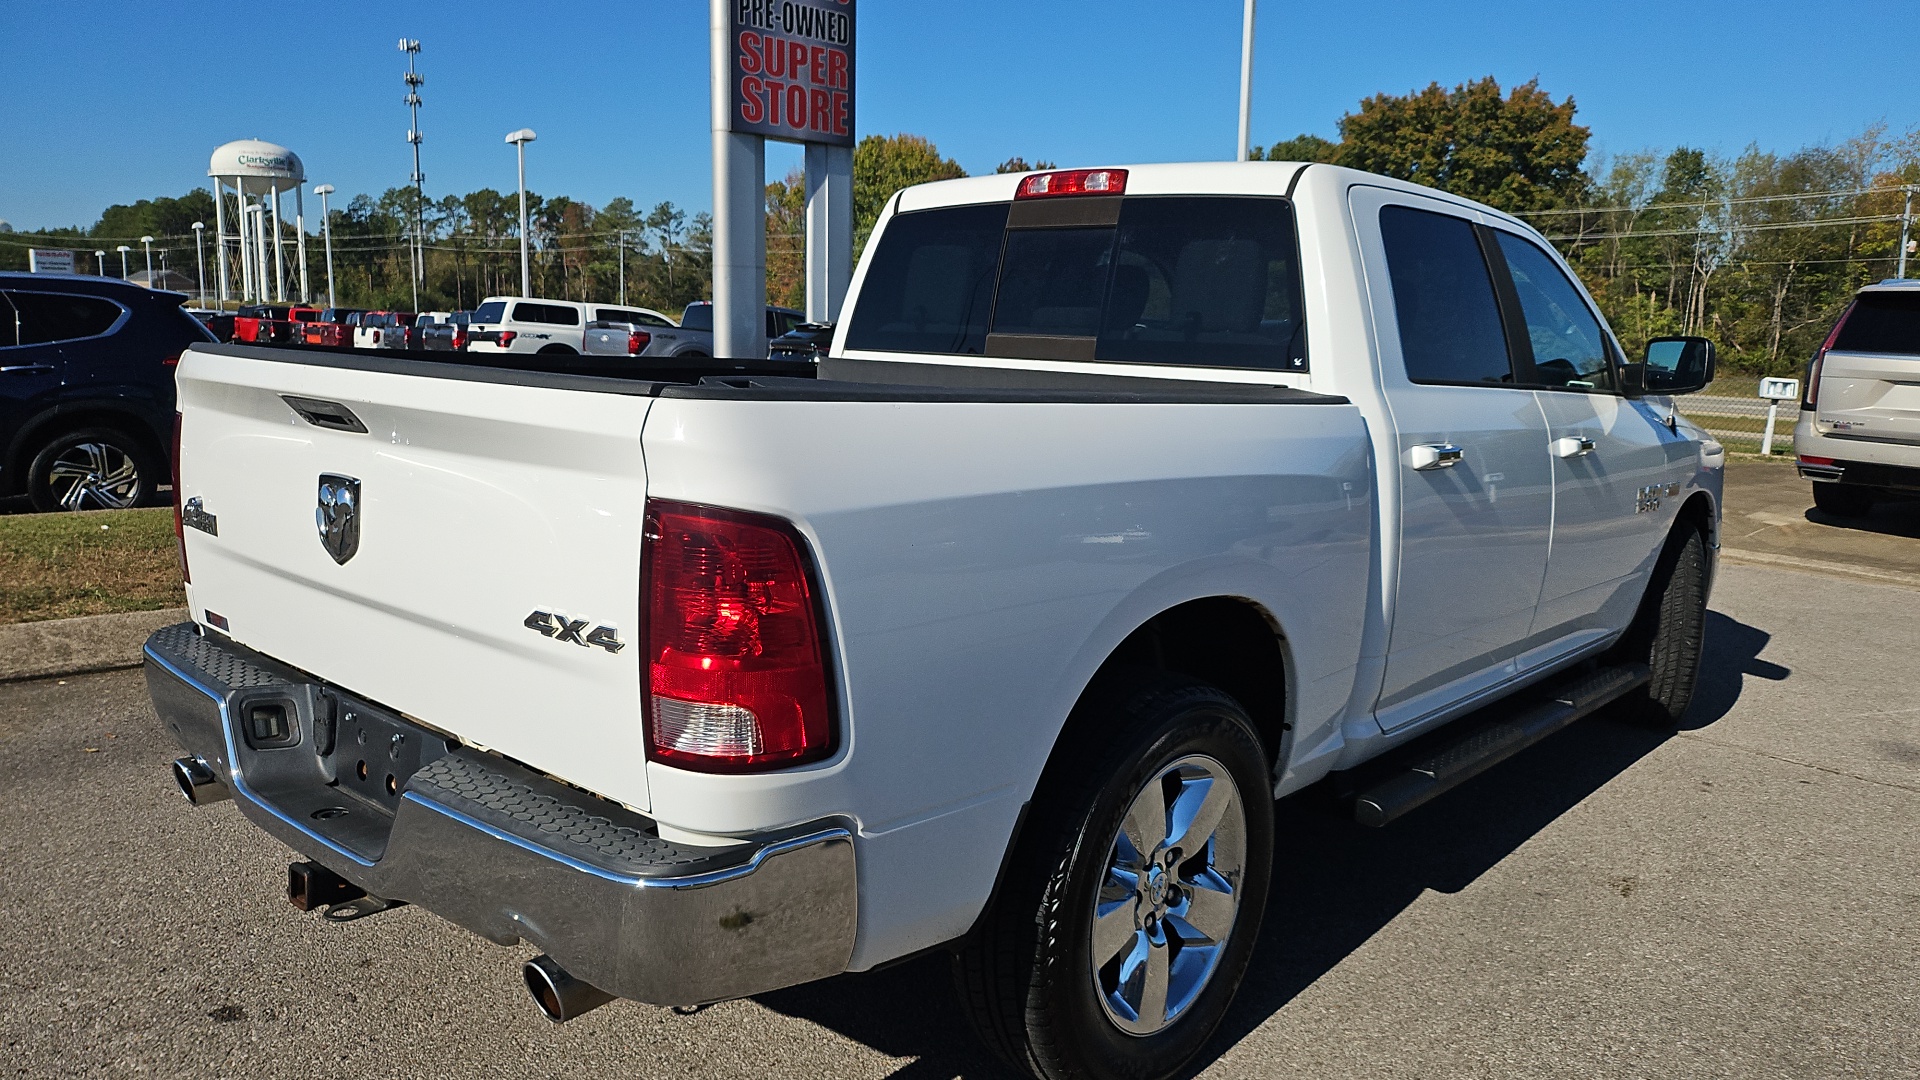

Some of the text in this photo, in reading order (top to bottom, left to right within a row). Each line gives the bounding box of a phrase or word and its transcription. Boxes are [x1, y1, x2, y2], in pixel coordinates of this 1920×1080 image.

[738, 0, 849, 46] PRE-OWNED
[739, 31, 848, 90] SUPER
[741, 75, 848, 136] STORE
